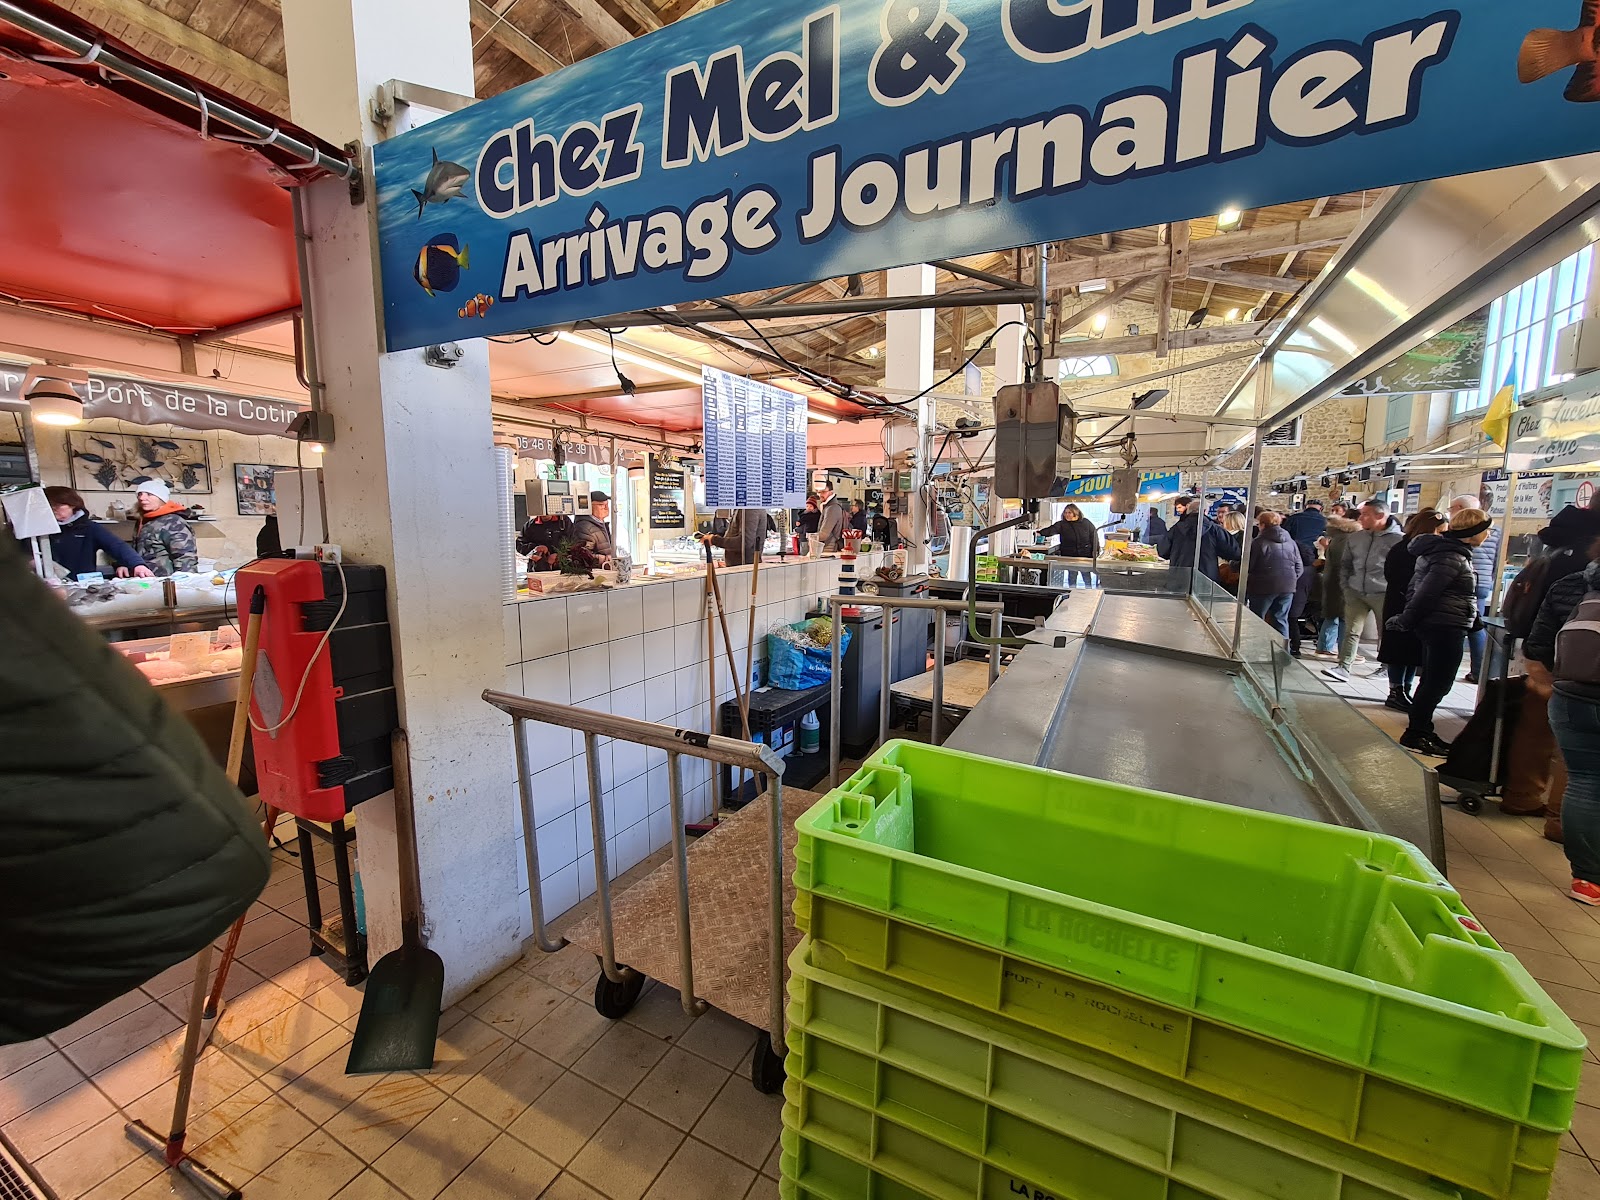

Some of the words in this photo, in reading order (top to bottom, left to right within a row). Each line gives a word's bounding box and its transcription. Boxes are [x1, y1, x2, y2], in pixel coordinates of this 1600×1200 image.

[475, 103, 645, 219] Chez
[661, 4, 841, 170] Mel
[868, 0, 969, 107] &
[500, 186, 779, 300] Arrivage
[801, 15, 1454, 241] Journalier
[87, 378, 153, 407] Port
[165, 389, 196, 413] de
[205, 394, 228, 417] la
[1517, 415, 1541, 437] Chez
[532, 438, 545, 451] 46
[575, 443, 586, 455] 39
[1525, 494, 1533, 502] Mer
[1529, 506, 1537, 515] Mer
[1024, 904, 1051, 934] LA
[1057, 914, 1178, 971] ROCHELLE
[1053, 986, 1075, 999] LA
[1009, 1179, 1029, 1199] LA
